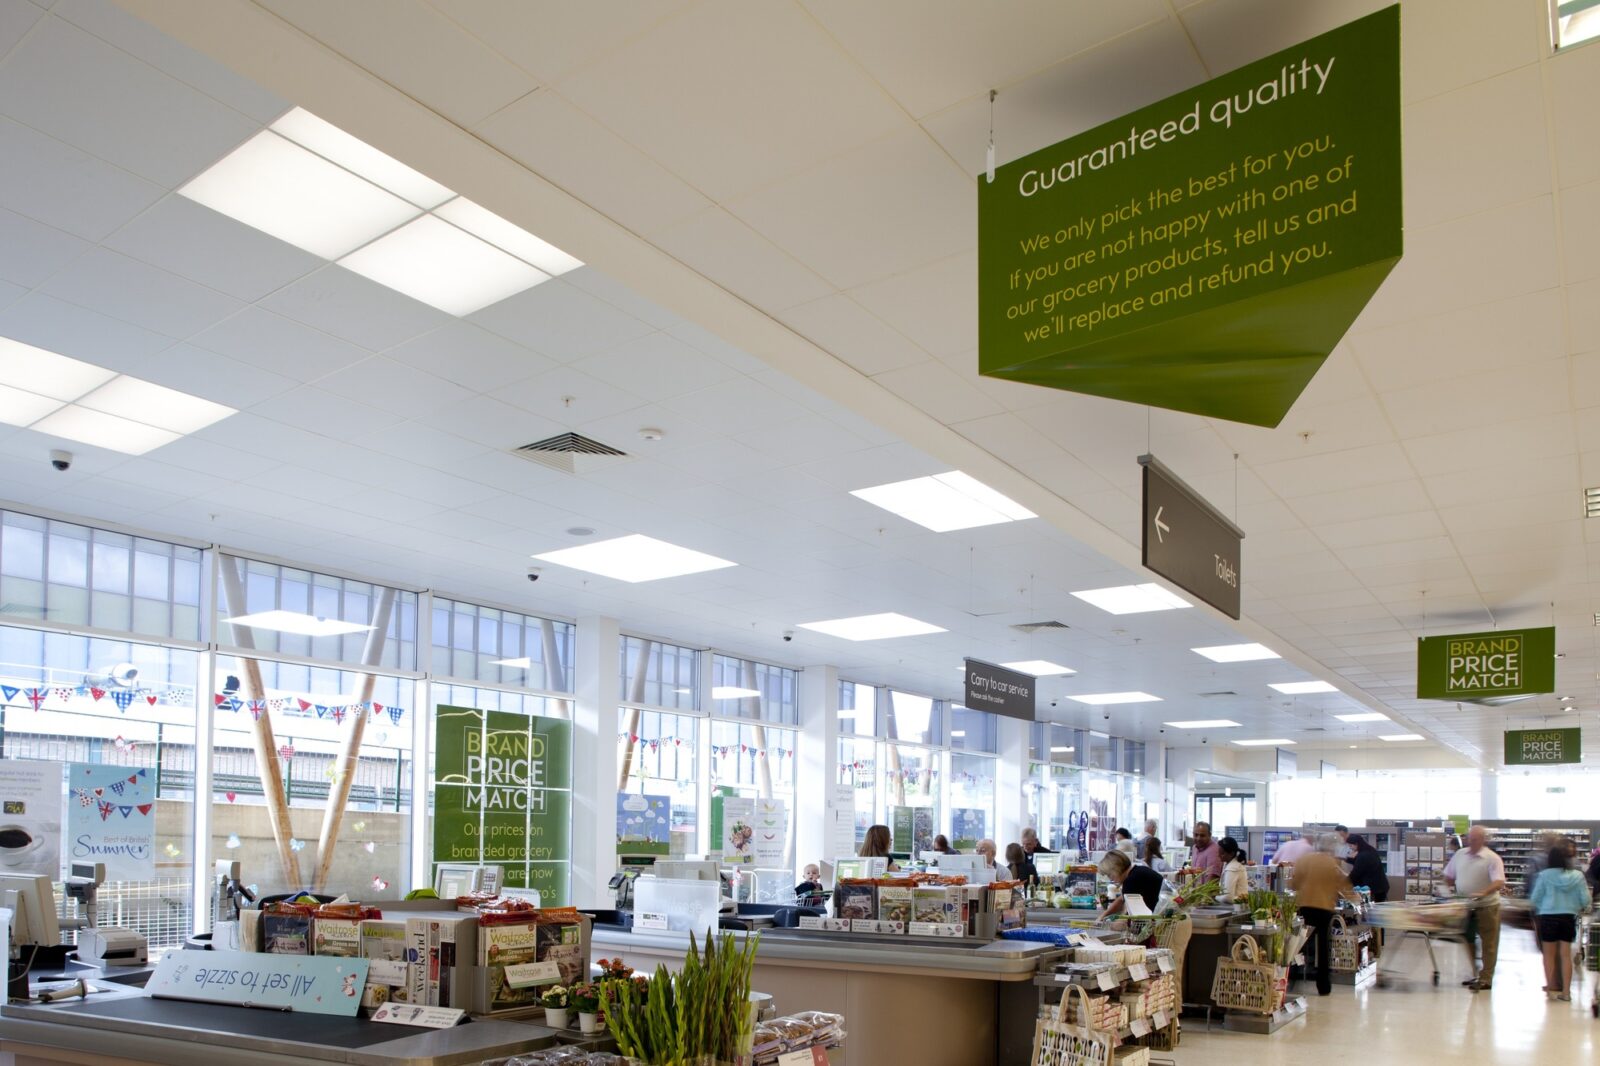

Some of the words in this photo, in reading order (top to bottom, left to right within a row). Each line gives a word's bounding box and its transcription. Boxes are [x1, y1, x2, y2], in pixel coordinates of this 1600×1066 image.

[1018, 100, 1200, 197] Guaranteed
[1209, 56, 1336, 129] quality
[1020, 234, 1050, 255] We
[1054, 217, 1096, 244] only
[1102, 198, 1142, 234] pick
[1148, 187, 1183, 211] the
[1188, 162, 1237, 197] best
[1243, 153, 1277, 178] for
[1283, 135, 1336, 171] you.
[1010, 268, 1021, 290] If
[1024, 261, 1059, 290] you
[1063, 249, 1096, 271] are
[1101, 230, 1135, 259] not
[1140, 210, 1211, 246] happy
[1216, 188, 1266, 219] with
[1272, 174, 1320, 201] one
[1326, 154, 1354, 183] of
[1006, 298, 1038, 320] our
[1042, 271, 1120, 314] grocery
[1125, 237, 1228, 289] products,
[1233, 218, 1267, 248] tell
[1274, 215, 1300, 235] us
[1306, 189, 1357, 225] and
[1023, 315, 1064, 343] we'll
[1069, 296, 1145, 331] replace
[1149, 275, 1193, 306] and
[1199, 250, 1274, 293] refund
[1280, 241, 1333, 275] you.
[1214, 553, 1237, 588] Toilets
[1450, 638, 1520, 656] BRAND
[1450, 653, 1519, 673] PRICE
[970, 672, 989, 691] Carry
[990, 676, 998, 690] to
[998, 681, 1008, 692] car
[1008, 684, 1029, 698] service
[1450, 672, 1519, 689] MATCH
[467, 731, 545, 758] BRAND
[1522, 733, 1561, 742] BRAND
[1522, 741, 1561, 751] PRICE
[1522, 751, 1562, 760] MATCH
[467, 755, 544, 785] PRICE
[466, 787, 544, 810] MATCH
[103, 835, 119, 843] Best
[463, 822, 489, 836] Our
[491, 822, 524, 839] prices
[530, 826, 544, 836] on
[73, 834, 149, 860] Summer
[452, 843, 506, 858] branded
[507, 846, 553, 860] grocery
[507, 869, 527, 880] are
[531, 868, 554, 879] now
[318, 923, 359, 935] Waitrose
[490, 931, 535, 944] Waitrose
[413, 933, 426, 992] weekend
[194, 967, 238, 991] sizzle
[241, 971, 259, 993] to
[262, 972, 290, 994] set
[291, 974, 316, 996] All
